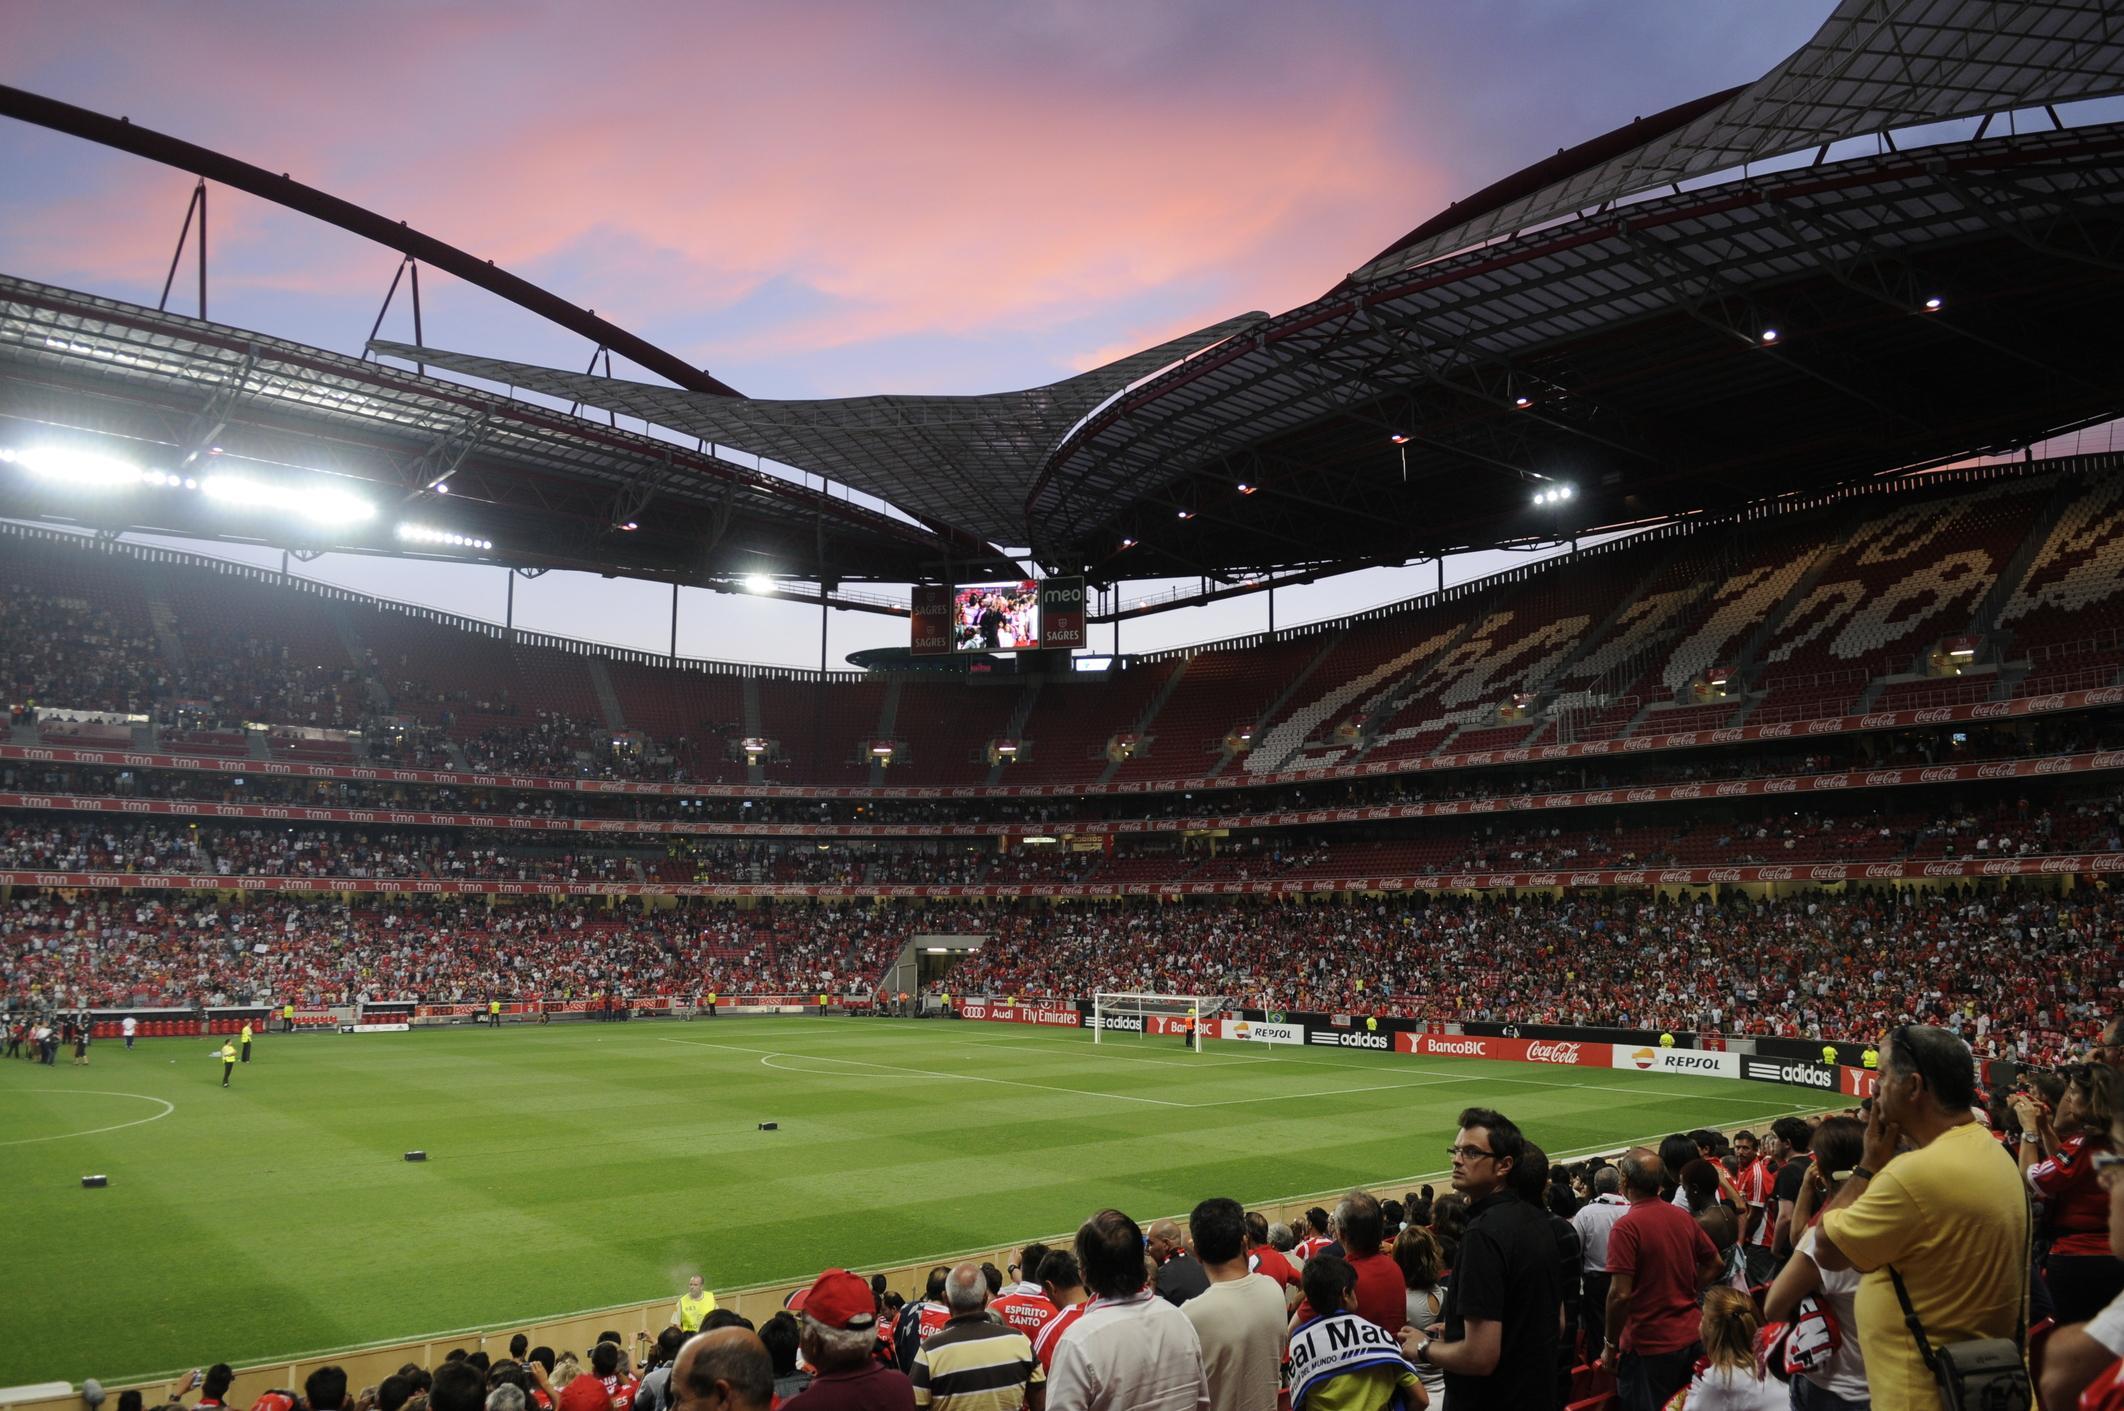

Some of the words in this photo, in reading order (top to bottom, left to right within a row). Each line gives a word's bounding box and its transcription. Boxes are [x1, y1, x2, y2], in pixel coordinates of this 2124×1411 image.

[1045, 588, 1081, 603] meo
[915, 637, 946, 648] SAGRES
[1046, 630, 1079, 641] SAGRES
[22, 747, 54, 761] tmn
[74, 751, 104, 764] tmn
[122, 754, 152, 767] tmn
[172, 757, 200, 769] tmn
[218, 760, 246, 772] tmn
[264, 763, 290, 774] tmn
[308, 765, 334, 777] tmn
[352, 768, 376, 779] tmn
[392, 771, 418, 781] tmn
[434, 773, 456, 783] tmn
[474, 776, 496, 786] tmn
[512, 779, 534, 788] tmn
[548, 782, 570, 791] tmn
[20, 798, 52, 809] tmn
[72, 800, 102, 811] tmn
[120, 802, 150, 813] tmn
[168, 803, 198, 815] tmn
[216, 805, 244, 816] tmn
[262, 807, 288, 818] tmn
[306, 809, 332, 820] tmn
[348, 810, 374, 822] tmn
[390, 812, 414, 824] tmn
[432, 814, 454, 825] tmn
[470, 816, 494, 827] tmn
[508, 817, 530, 828] tmn
[546, 818, 568, 830] tmn
[34, 875, 68, 886] tmn
[88, 876, 120, 887] tmn
[140, 877, 170, 888] tmn
[190, 878, 218, 889] tmn
[236, 879, 266, 889] tmn
[284, 880, 312, 890] tmn
[330, 881, 356, 891] tmn
[374, 881, 400, 891] tmn
[416, 882, 442, 892] tmn
[458, 882, 482, 892] tmn
[498, 883, 522, 893] tmn
[538, 884, 560, 893] tmn
[568, 884, 588, 894] tmn
[992, 1008, 1014, 1019] Audi
[1023, 1008, 1038, 1024] Fly
[1039, 1011, 1077, 1025] Emirates
[1106, 1015, 1142, 1030] adidas
[1171, 1021, 1213, 1034] BanBIC
[1255, 1027, 1292, 1039] REPSOL
[1340, 1031, 1388, 1049] adidas
[1428, 1038, 1486, 1056] BancoBIC
[1526, 1040, 1581, 1065] Coca-Cola
[1665, 1055, 1721, 1070] REPSOL
[1781, 1063, 1832, 1088] adidas
[1008, 1315, 1041, 1327] SANTO
[1287, 1332, 1316, 1378] eal
[1311, 1355, 1337, 1370] MUNDO
